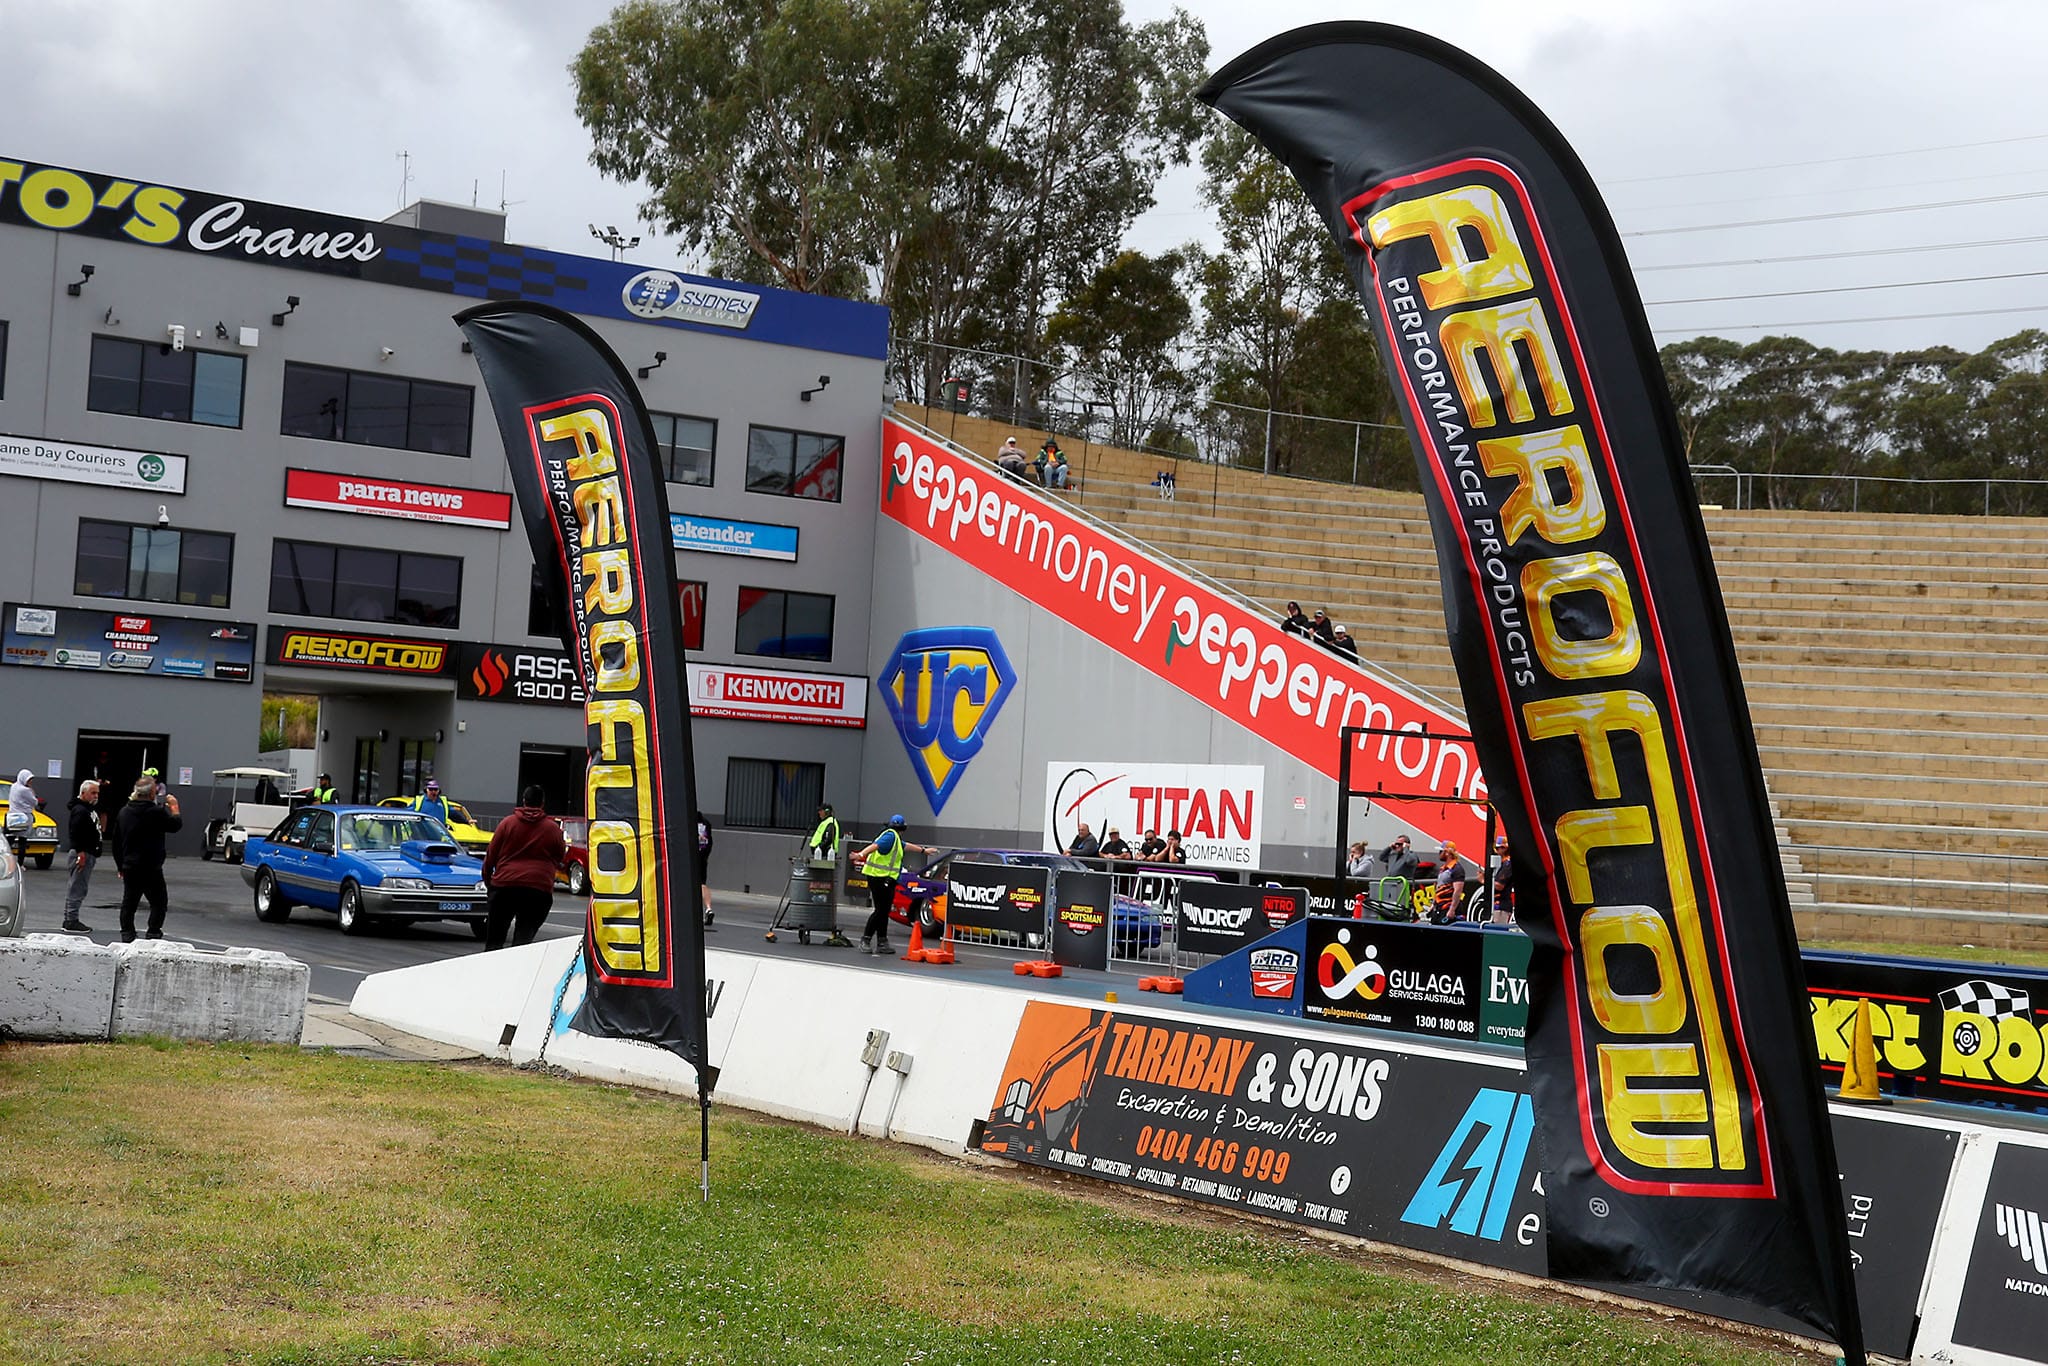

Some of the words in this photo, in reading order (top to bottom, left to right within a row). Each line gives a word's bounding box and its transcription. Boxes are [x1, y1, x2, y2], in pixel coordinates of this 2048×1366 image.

[188, 201, 382, 262] Cranes
[676, 305, 745, 321] DRAGWAY
[681, 290, 752, 314] SYDNEY
[35, 446, 61, 461] Day
[66, 450, 126, 467] Couriers
[1387, 276, 1488, 507] PERFORMANCE
[1474, 518, 1535, 687] PRODUCTS
[338, 481, 400, 501] parra
[404, 489, 463, 510] news
[671, 520, 754, 545] ekender
[548, 459, 583, 593] PERFORMANCE
[575, 599, 596, 694] PRODUCTS
[105, 631, 159, 643] CHAMPIONSHIP
[115, 641, 148, 650] SERIES
[284, 635, 443, 669] AEROFLOW
[296, 654, 336, 663] PERFORMANCE
[337, 657, 365, 665] PRODUCTS
[514, 681, 565, 699] 1300
[1368, 184, 1746, 1170] AEROFLOW
[540, 408, 660, 973] AEROFLOW
[727, 677, 840, 704] KENWORTH
[1129, 786, 1253, 840] TITAN
[1185, 843, 1250, 863] COMPANIES
[1009, 892, 1041, 904] SPORTSMAN
[1263, 898, 1294, 911] NITRO
[1061, 910, 1103, 925] SPORTSMAN
[1389, 969, 1465, 996] GULAGA
[1389, 989, 1423, 1001] SERVICES
[1424, 993, 1465, 1006] AUSTRALIA
[1306, 1004, 1393, 1023] www.gulagaservices.com.au
[1415, 1014, 1436, 1029] 1300
[1439, 1017, 1456, 1031] 180
[1457, 1020, 1475, 1034] 088
[1104, 1022, 1255, 1097] TARABAY
[1248, 1053, 1277, 1103] &
[1281, 1048, 1390, 1121] SONS
[1233, 1108, 1337, 1145] Demolition
[1135, 1125, 1193, 1164] 0404
[1194, 1137, 1240, 1174] 466
[1242, 1146, 1290, 1184] 999
[1048, 1148, 1064, 1162] CIVIL
[1064, 1151, 1087, 1168] WORKS
[1091, 1158, 1131, 1177] CONCRETING
[1135, 1166, 1177, 1187] ASPHALTING
[1180, 1178, 1217, 1196] RETAINING
[1217, 1184, 1242, 1202] WALLS
[1246, 1190, 1298, 1214] LANDSCAPING
[1304, 1202, 1329, 1222] TRUCK
[1329, 1207, 1349, 1226] HIRE
[1848, 1194, 1873, 1237] Ltd
